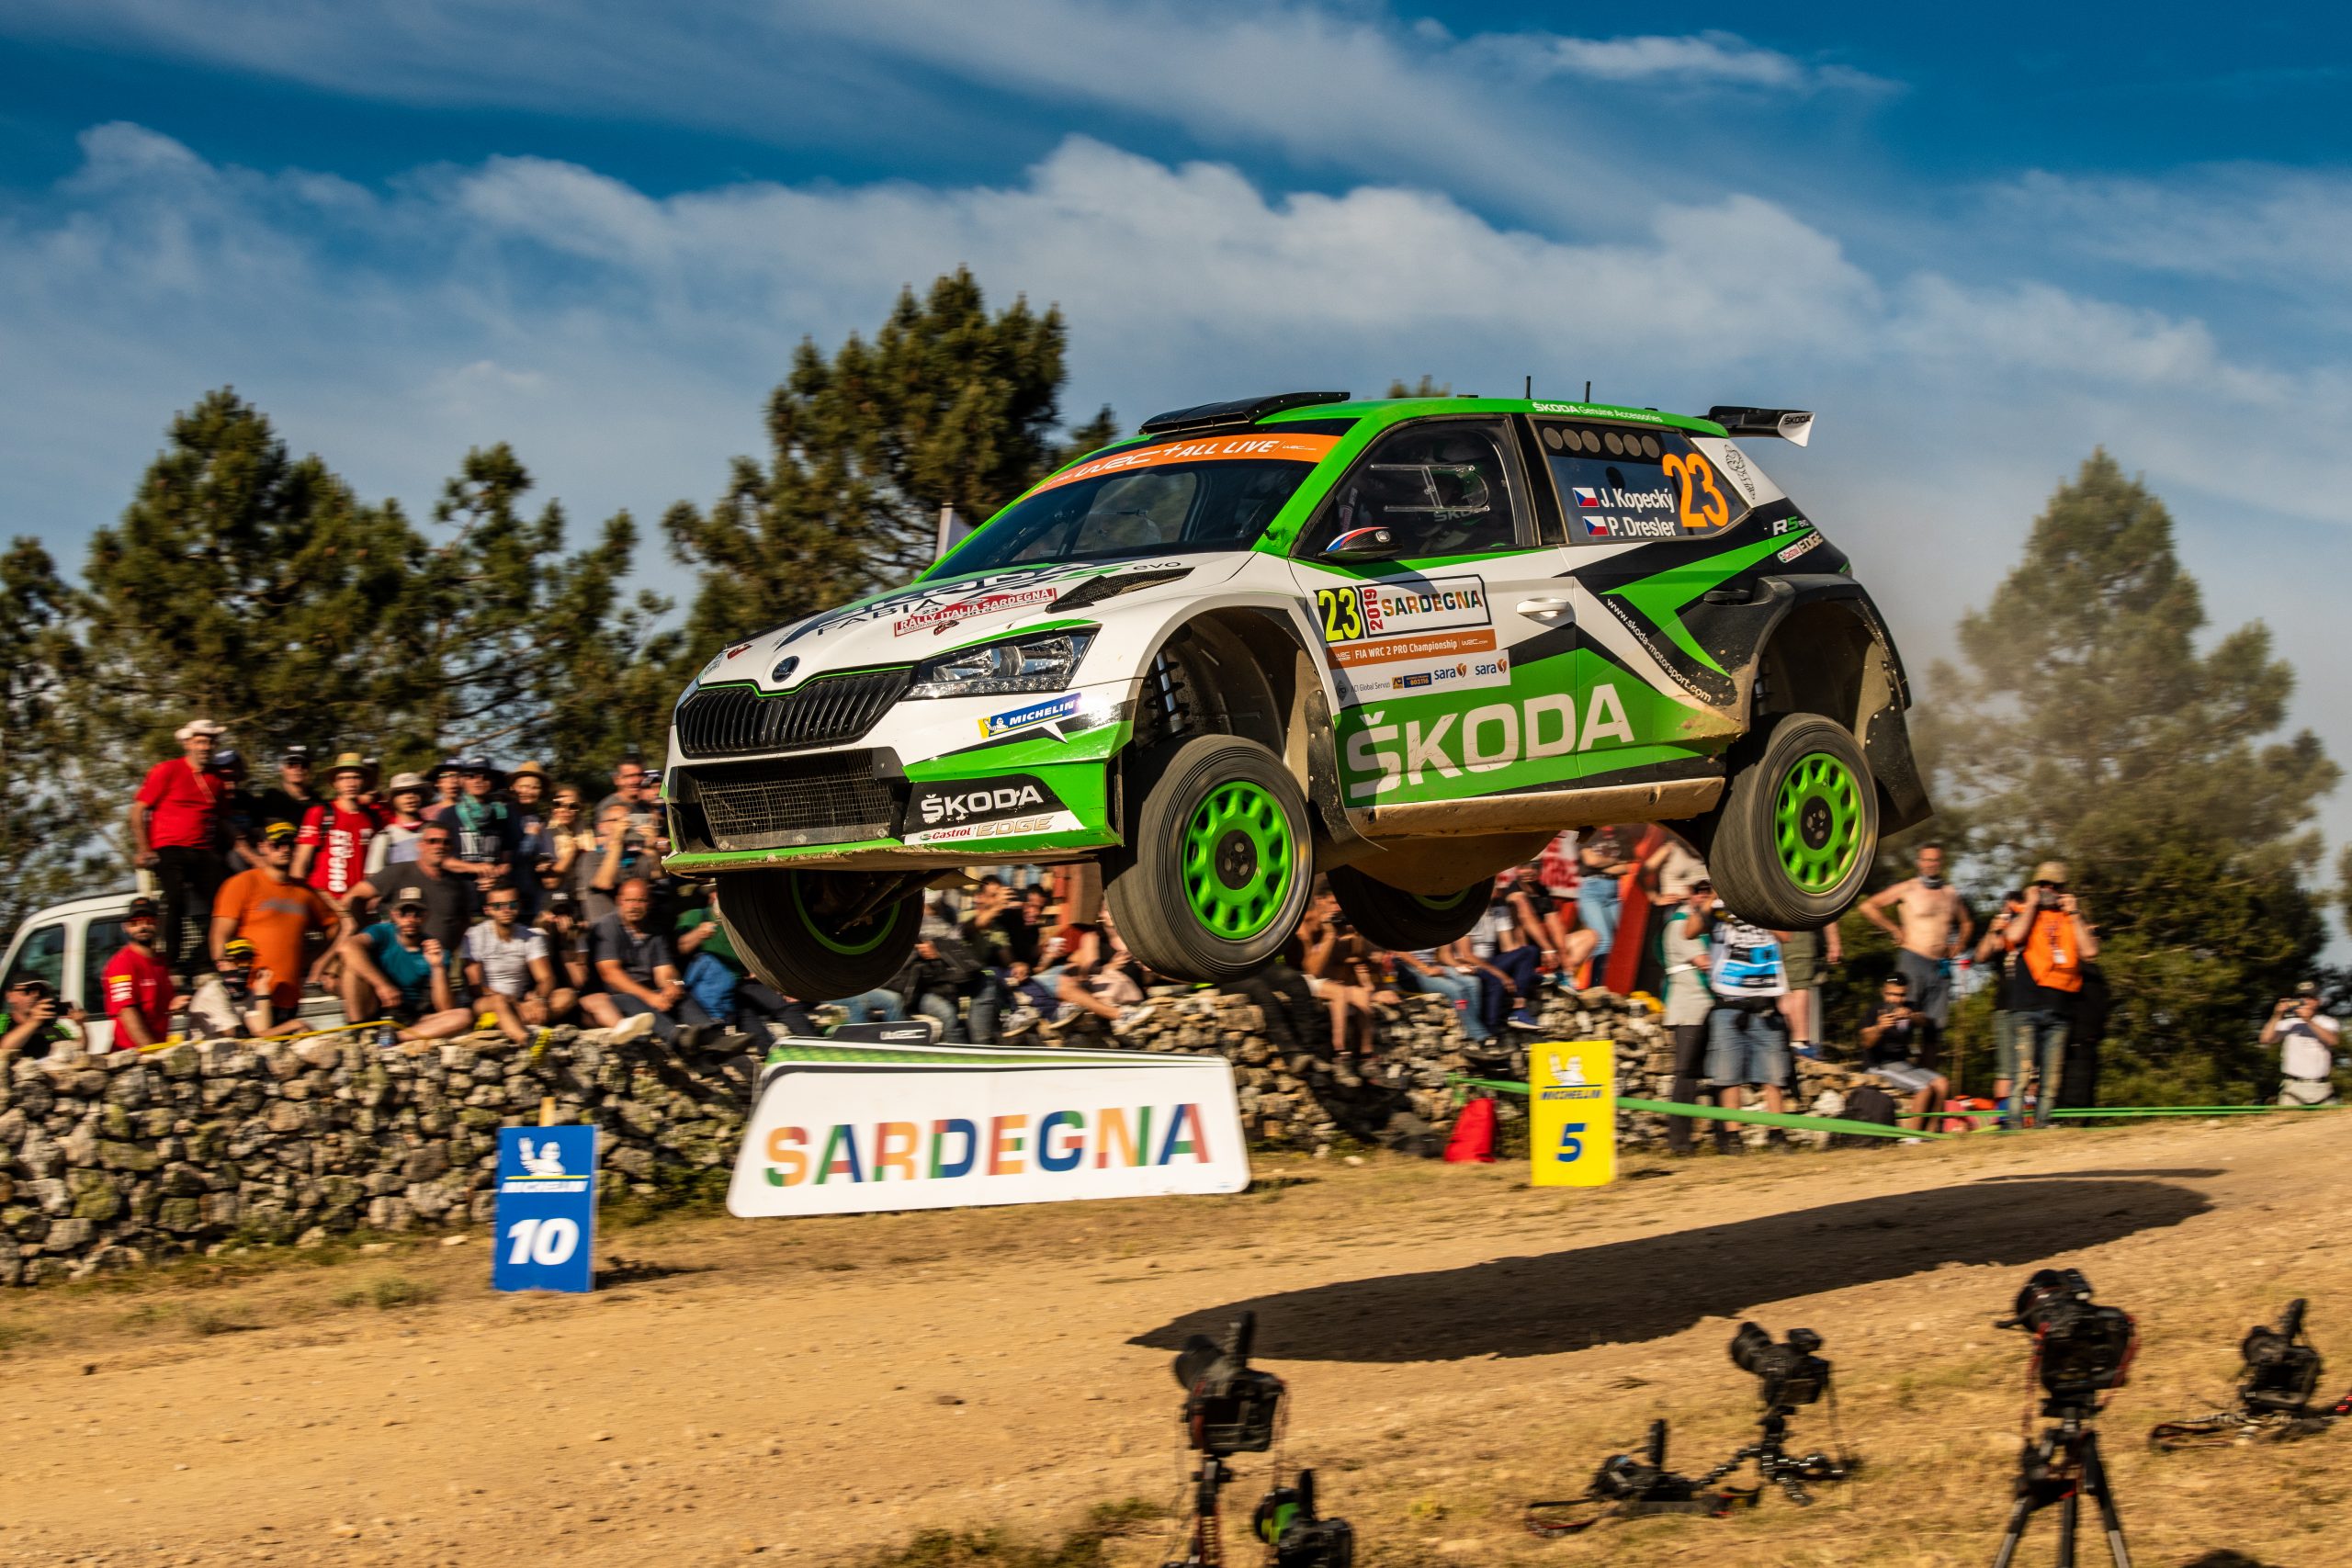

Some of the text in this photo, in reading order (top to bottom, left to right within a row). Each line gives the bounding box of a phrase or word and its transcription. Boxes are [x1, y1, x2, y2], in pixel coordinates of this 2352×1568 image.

[1578, 405, 1614, 417] Genuine
[1614, 410, 1663, 423] Accessories
[1222, 441, 1281, 454] LIVE
[1600, 487, 1675, 513] J. Kopecký
[1662, 453, 1729, 528] 23
[1607, 516, 1676, 536] P. Dresler
[1133, 561, 1182, 570] evo
[899, 613, 940, 630] RALLY
[939, 604, 980, 620] ITALIA
[982, 590, 1049, 609] SARDEGNA
[1318, 588, 1362, 642] 23
[1363, 588, 1385, 631] 2019
[1381, 590, 1484, 617] SARDEGNA
[1355, 649, 1368, 660] FIA
[1368, 647, 1385, 658] WRC
[1385, 646, 1392, 656] 2
[1393, 644, 1408, 655] PRO
[1409, 639, 1458, 652] Championship
[1607, 598, 1712, 702] www.skoda-motorsport.com
[1434, 668, 1456, 681] sara
[1475, 663, 1497, 675] sara
[1009, 700, 1076, 725] MICHELIN
[1346, 682, 1635, 799] ŠKODA
[921, 784, 1044, 824] ŠKODA
[932, 815, 1056, 840] Castrol EDGE
[762, 1102, 1214, 1188] SARDEGNA
[1555, 1122, 1588, 1163] 5
[507, 1217, 580, 1266] 10
